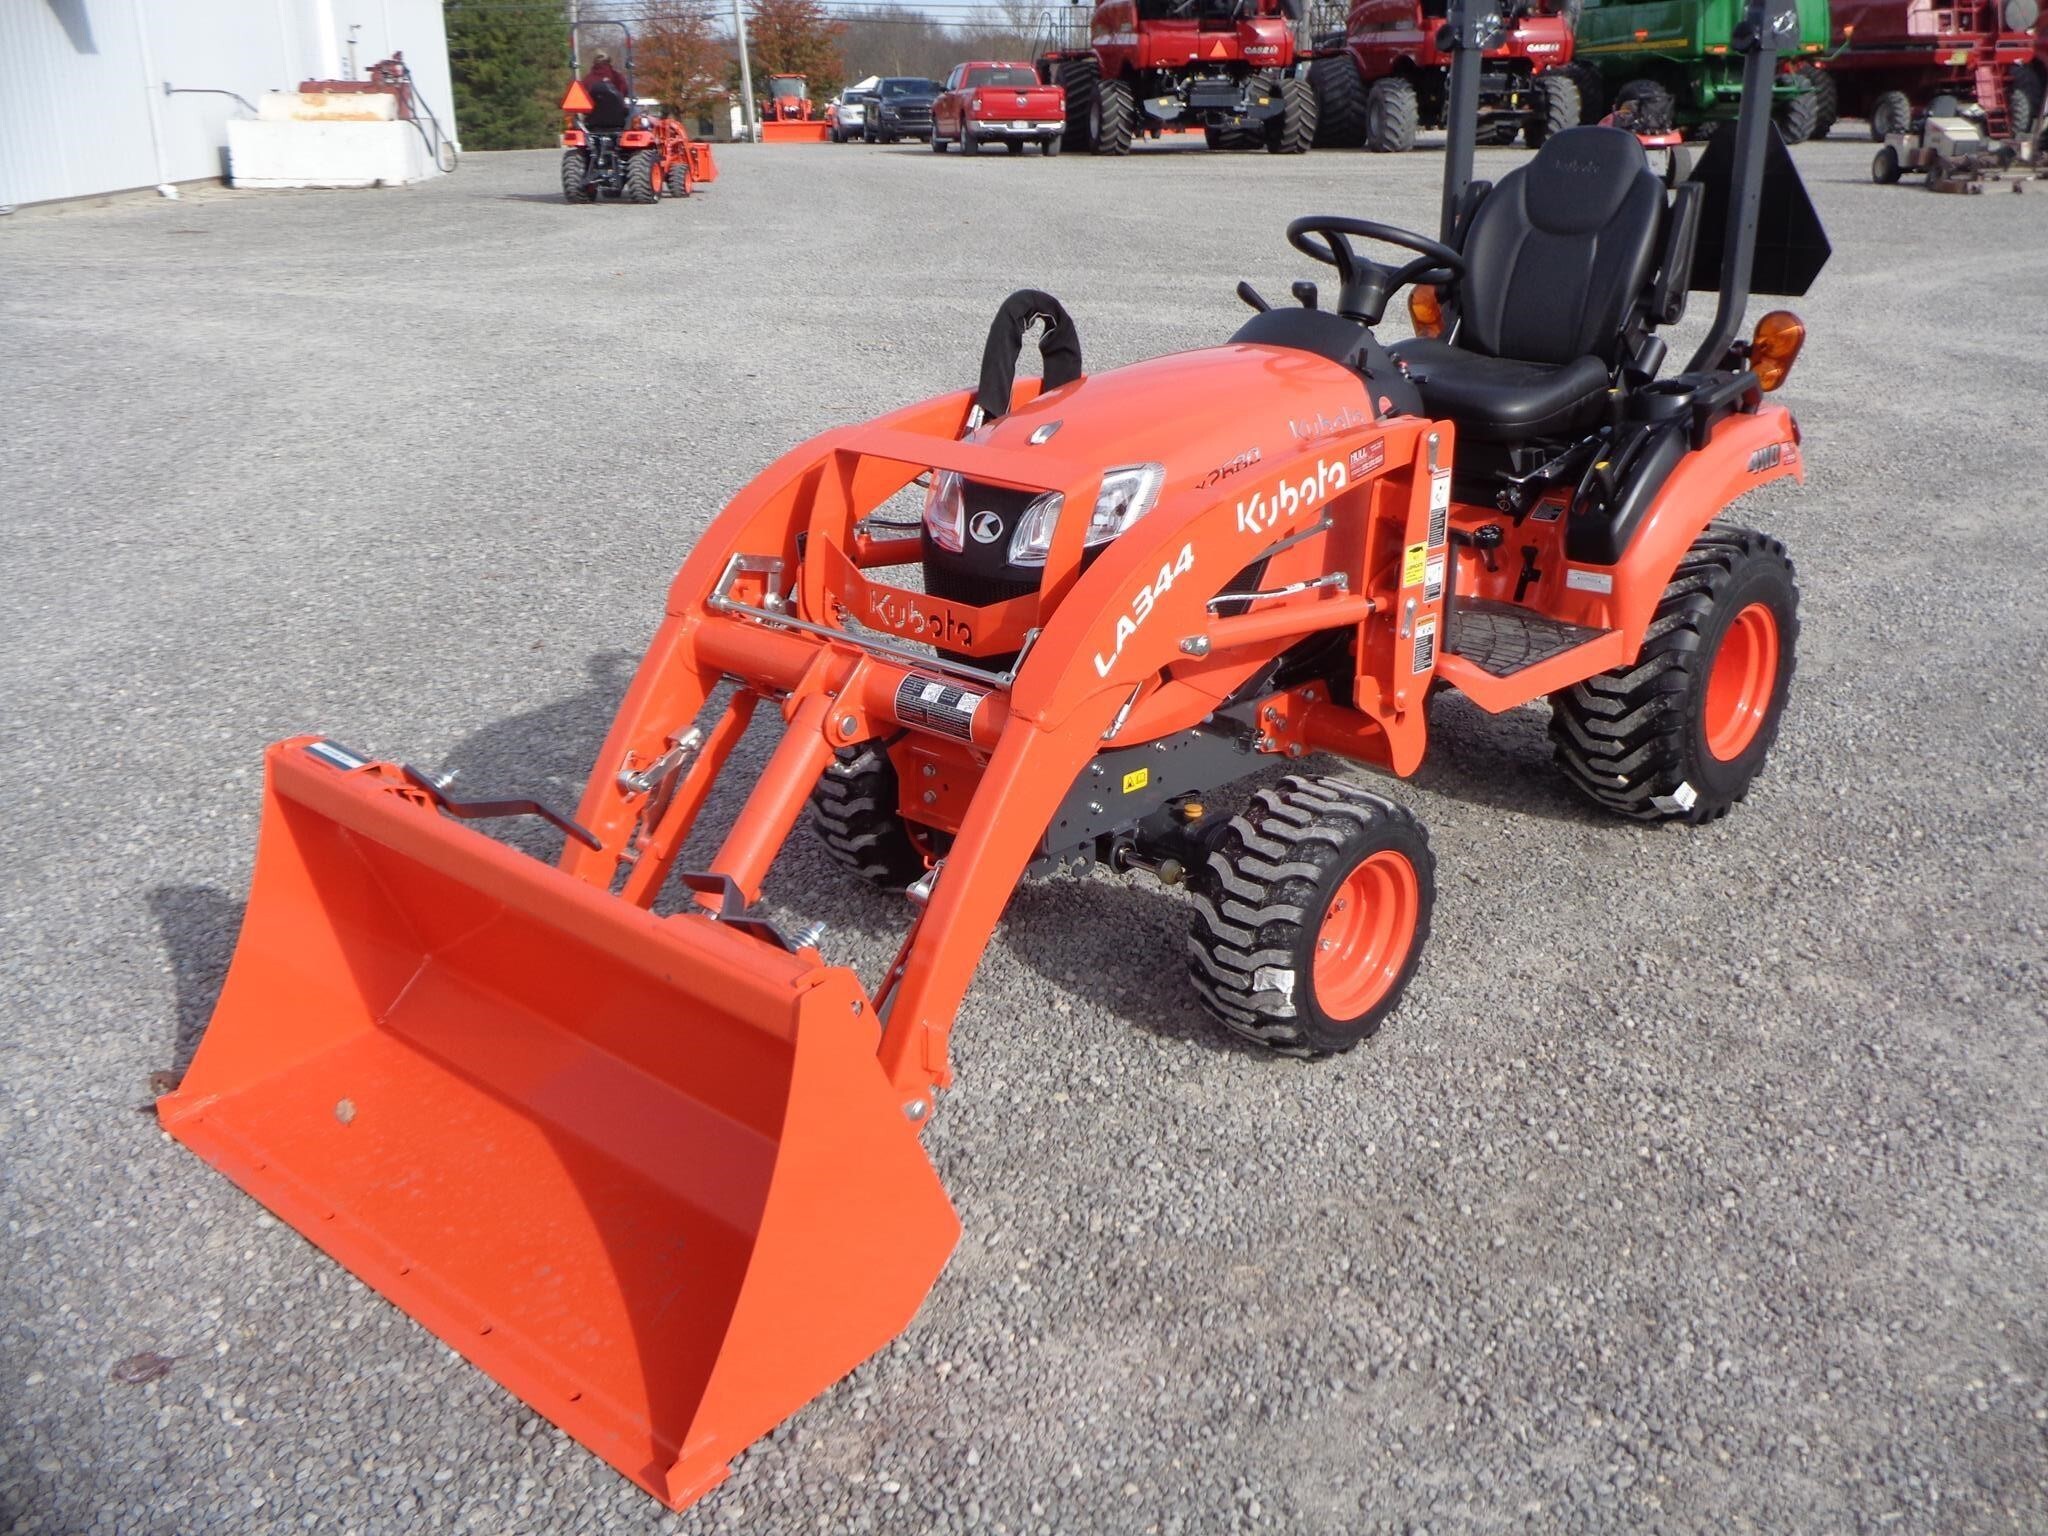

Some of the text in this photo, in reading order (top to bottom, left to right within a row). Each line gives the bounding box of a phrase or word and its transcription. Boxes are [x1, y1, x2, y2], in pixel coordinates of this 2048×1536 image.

[1244, 45, 1269, 55] CASE
[1288, 405, 1368, 439] Kubota
[1236, 458, 1347, 535] Kubota
[869, 590, 973, 647] Kubota
[1093, 542, 1195, 678] LA344
